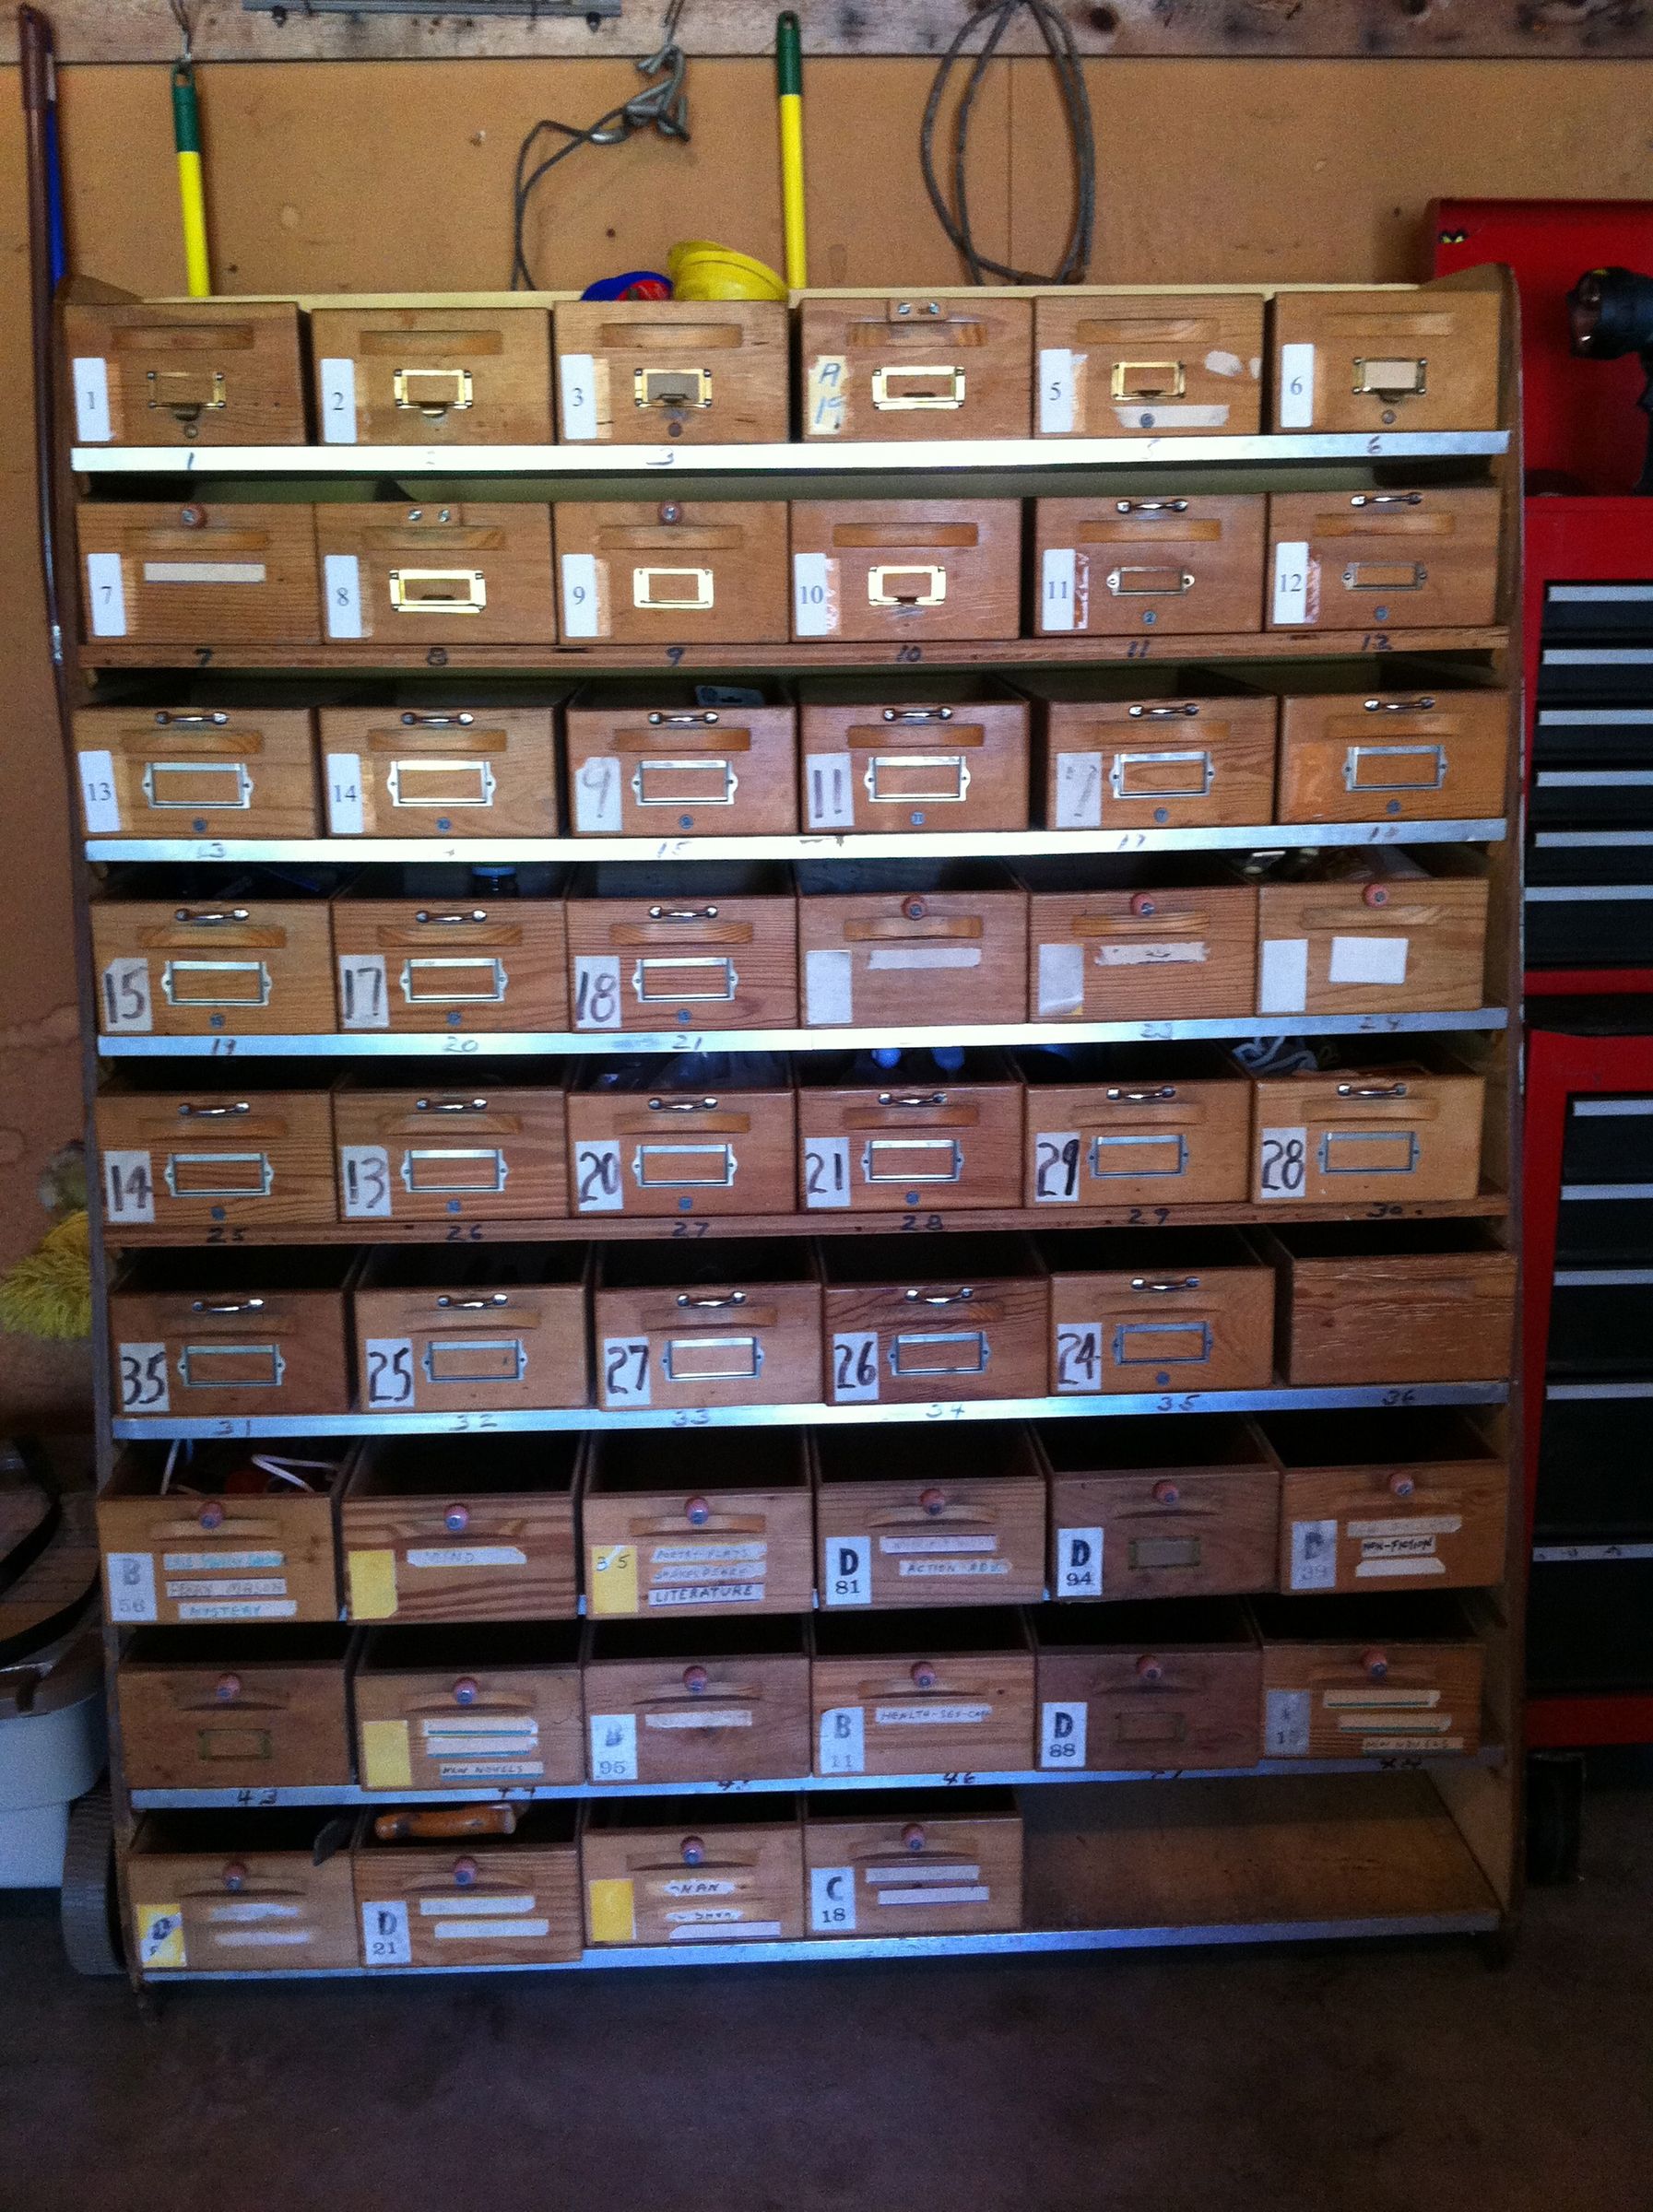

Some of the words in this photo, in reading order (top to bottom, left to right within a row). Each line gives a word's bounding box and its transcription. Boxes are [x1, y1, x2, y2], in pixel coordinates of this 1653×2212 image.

[1049, 382, 1061, 401] 5
[1290, 376, 1303, 394] 6
[87, 392, 97, 409] 1
[332, 393, 345, 411] 2
[572, 388, 584, 406] 3
[1366, 436, 1382, 454] 6
[1048, 582, 1069, 600] 11
[1280, 574, 1303, 593] 12
[100, 586, 112, 604] 7
[337, 588, 349, 606] 8
[573, 587, 585, 606] 9
[800, 586, 823, 605] 10
[1362, 633, 1394, 652] 12
[194, 650, 213, 666] 7
[666, 647, 684, 666] 9
[895, 646, 920, 663] 10
[88, 782, 112, 802] 13
[333, 784, 357, 803] 14
[104, 966, 148, 1023] 15
[344, 968, 382, 1019] 17
[577, 972, 617, 1022] 18
[443, 1035, 478, 1053] 20
[805, 1153, 844, 1194] 21
[1036, 1139, 1080, 1197] 29
[1263, 1139, 1304, 1191] 28
[348, 1158, 385, 1207] 13
[579, 1152, 620, 1203] 20
[111, 1164, 152, 1211] 14
[902, 1215, 943, 1231] 28
[1128, 1208, 1170, 1226] 29
[207, 1227, 245, 1243] 25
[447, 1226, 484, 1241] 26
[672, 1222, 709, 1238] 27
[836, 1341, 876, 1389] 26
[1057, 1332, 1100, 1384] 24
[120, 1351, 166, 1405] 35
[370, 1347, 412, 1402] 25
[606, 1345, 649, 1394] 27
[1158, 1395, 1200, 1412] 35
[1383, 1390, 1416, 1406] 36
[672, 1410, 710, 1427] 33
[926, 1403, 966, 1418] 34
[456, 1415, 498, 1431] 32
[1071, 1539, 1090, 1568] D
[1363, 1536, 1433, 1552] NON-FICTION
[840, 1547, 859, 1576] D
[835, 1580, 859, 1594] 81
[1066, 1572, 1093, 1586] 94
[655, 1584, 753, 1603] LITERATURE
[834, 1713, 851, 1739] B
[1054, 1712, 1074, 1739] D
[1049, 1743, 1077, 1758] 88
[600, 1760, 626, 1775] 95
[827, 1877, 843, 1901] C
[379, 1911, 398, 1936] D
[822, 1909, 845, 1923] 18
[372, 1942, 397, 1955] 21
